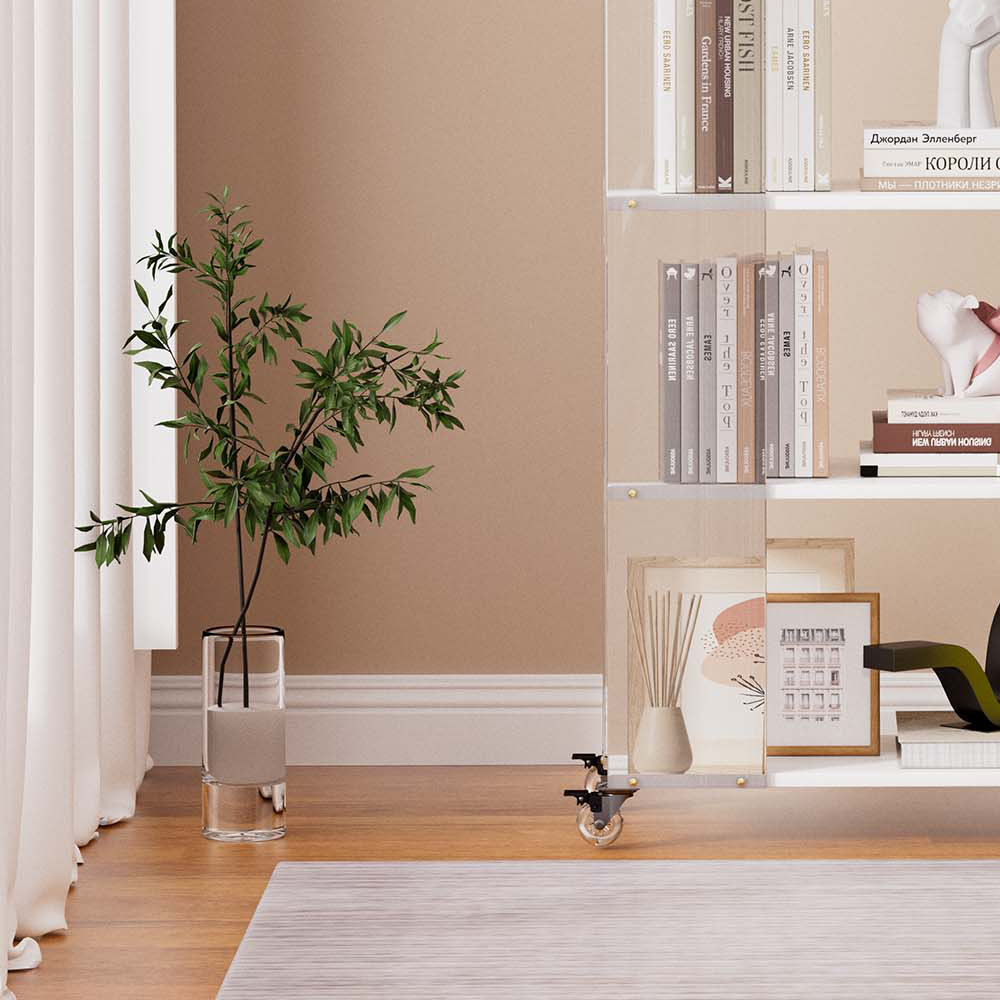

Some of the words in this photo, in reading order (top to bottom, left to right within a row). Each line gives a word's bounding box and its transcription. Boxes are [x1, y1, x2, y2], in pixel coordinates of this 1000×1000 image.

[723, 16, 731, 33] NEW
[663, 30, 671, 50] EERO
[723, 34, 731, 63] URBAN
[786, 27, 794, 48] ARNE
[802, 30, 810, 50] EERO
[701, 36, 712, 80] Gardens
[738, 31, 755, 72] FISH
[663, 52, 671, 92] SAARINEN
[723, 63, 731, 98] HOUSING
[786, 50, 794, 91] JACOBSEN
[802, 52, 810, 92] SAARINEN
[701, 82, 712, 93] in
[701, 95, 712, 133] France
[870, 133, 918, 145] Джордан
[922, 133, 977, 145] Элленберг
[925, 157, 991, 170] КОРОЛИ
[914, 180, 969, 190] ПЛОТНИКИ
